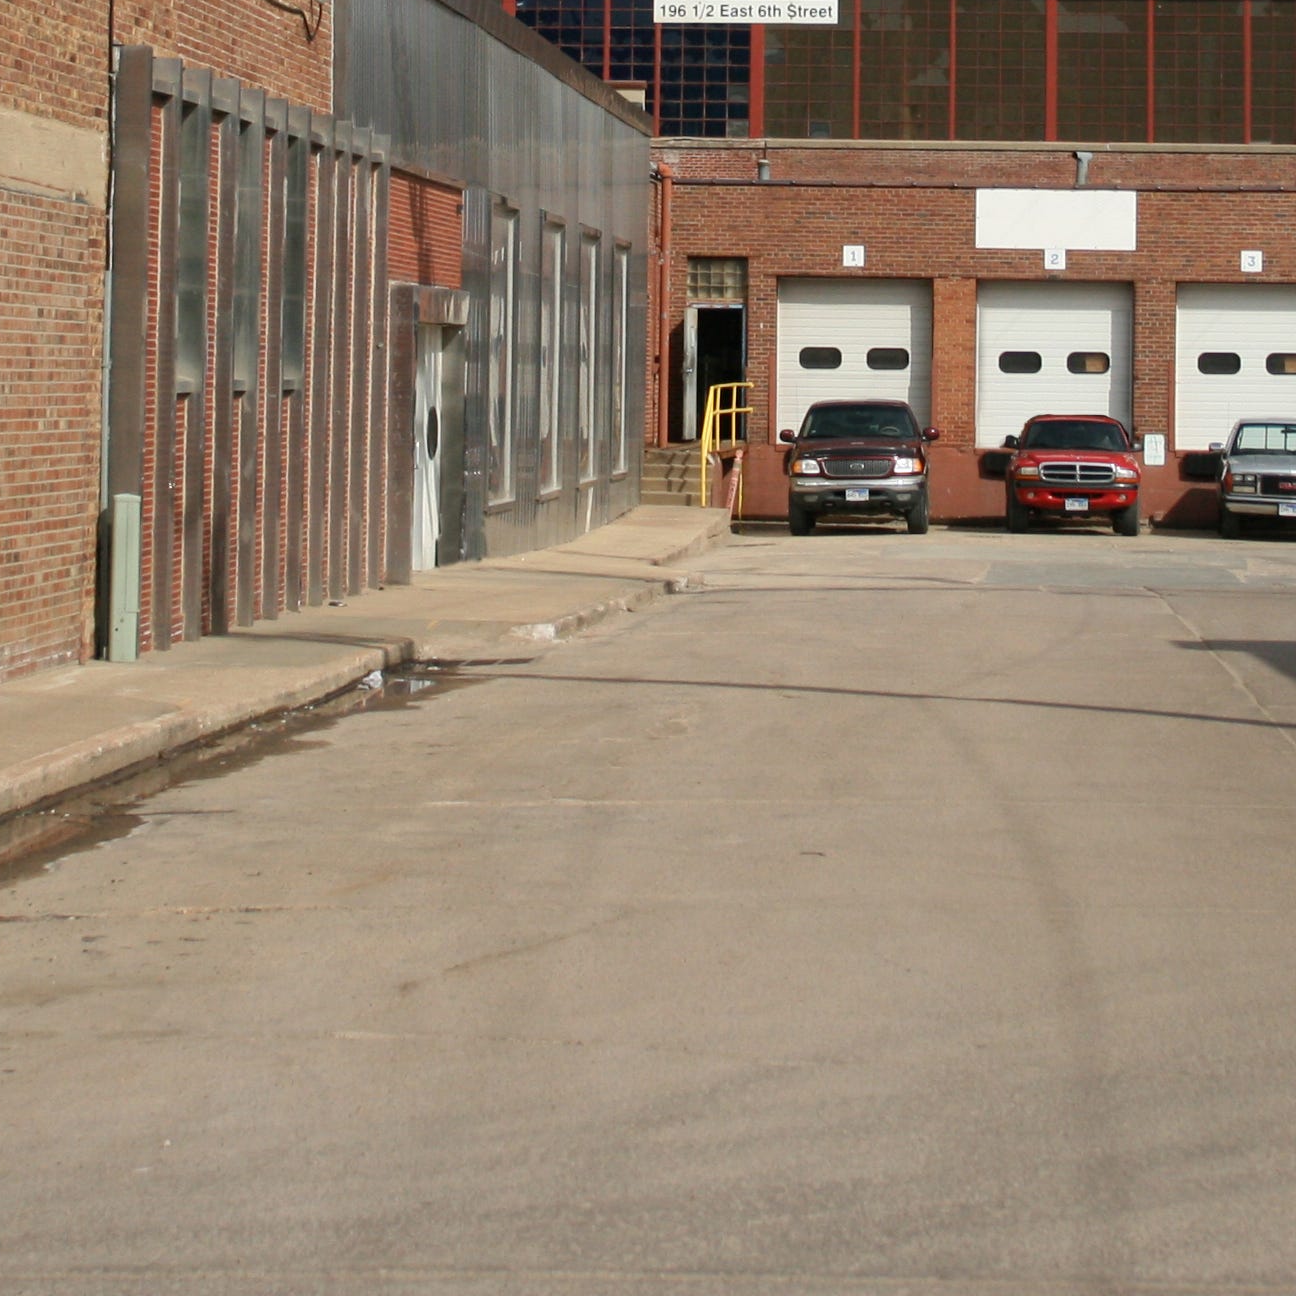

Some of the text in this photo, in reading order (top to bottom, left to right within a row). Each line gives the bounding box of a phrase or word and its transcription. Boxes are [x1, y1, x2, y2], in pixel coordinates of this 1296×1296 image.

[659, 3, 833, 20] 196 1/2 East 6th Street
[850, 250, 857, 262] 1
[1050, 253, 1059, 265] 2
[1247, 255, 1256, 267] 3
